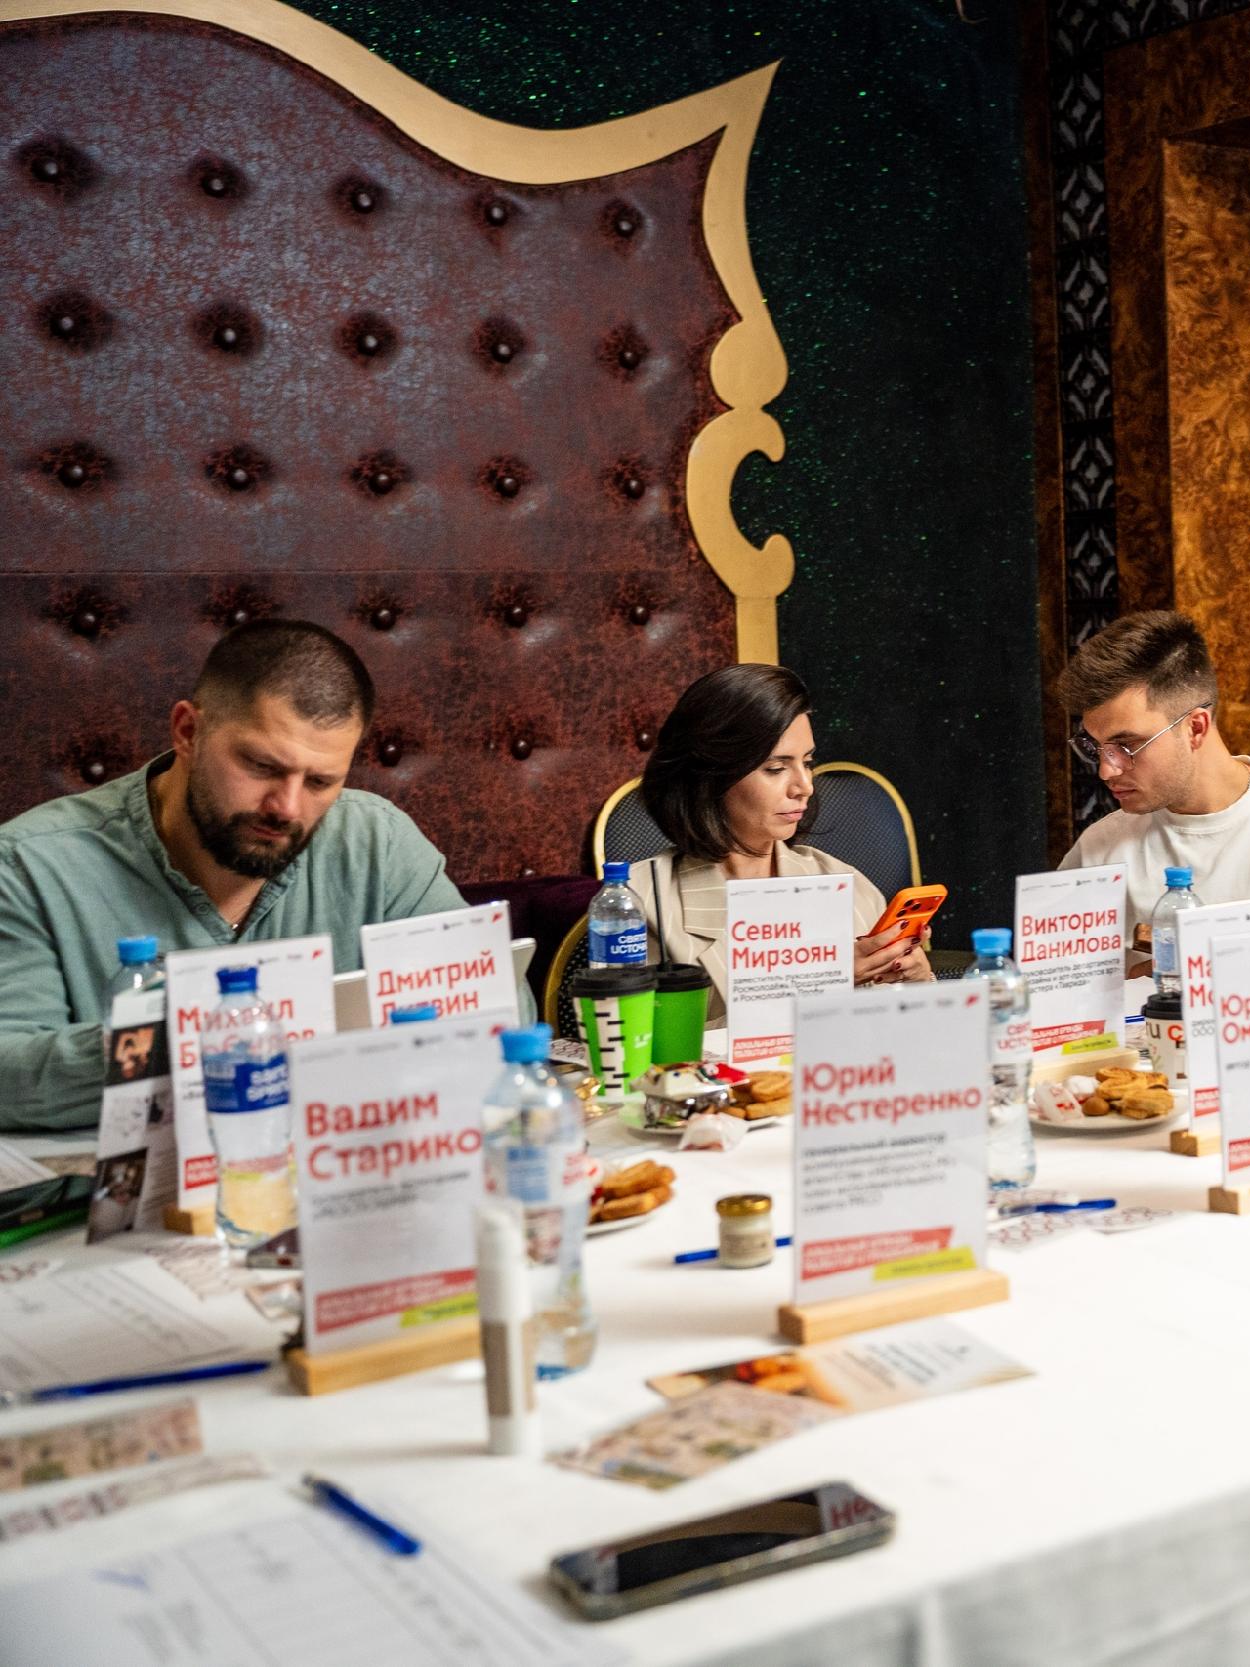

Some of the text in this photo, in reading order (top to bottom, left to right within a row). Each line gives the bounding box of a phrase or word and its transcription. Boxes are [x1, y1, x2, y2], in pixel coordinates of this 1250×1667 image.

[732, 921, 801, 941] Севик
[1022, 909, 1118, 936] Виктория
[732, 945, 837, 973] Мирзоян
[1021, 935, 1121, 963] Данилова
[377, 950, 495, 997] Дмитрий
[177, 999, 294, 1034] Михаил
[802, 1055, 896, 1097] Юрий
[305, 1091, 438, 1138] Вадим
[802, 1087, 982, 1128] Нестеренко
